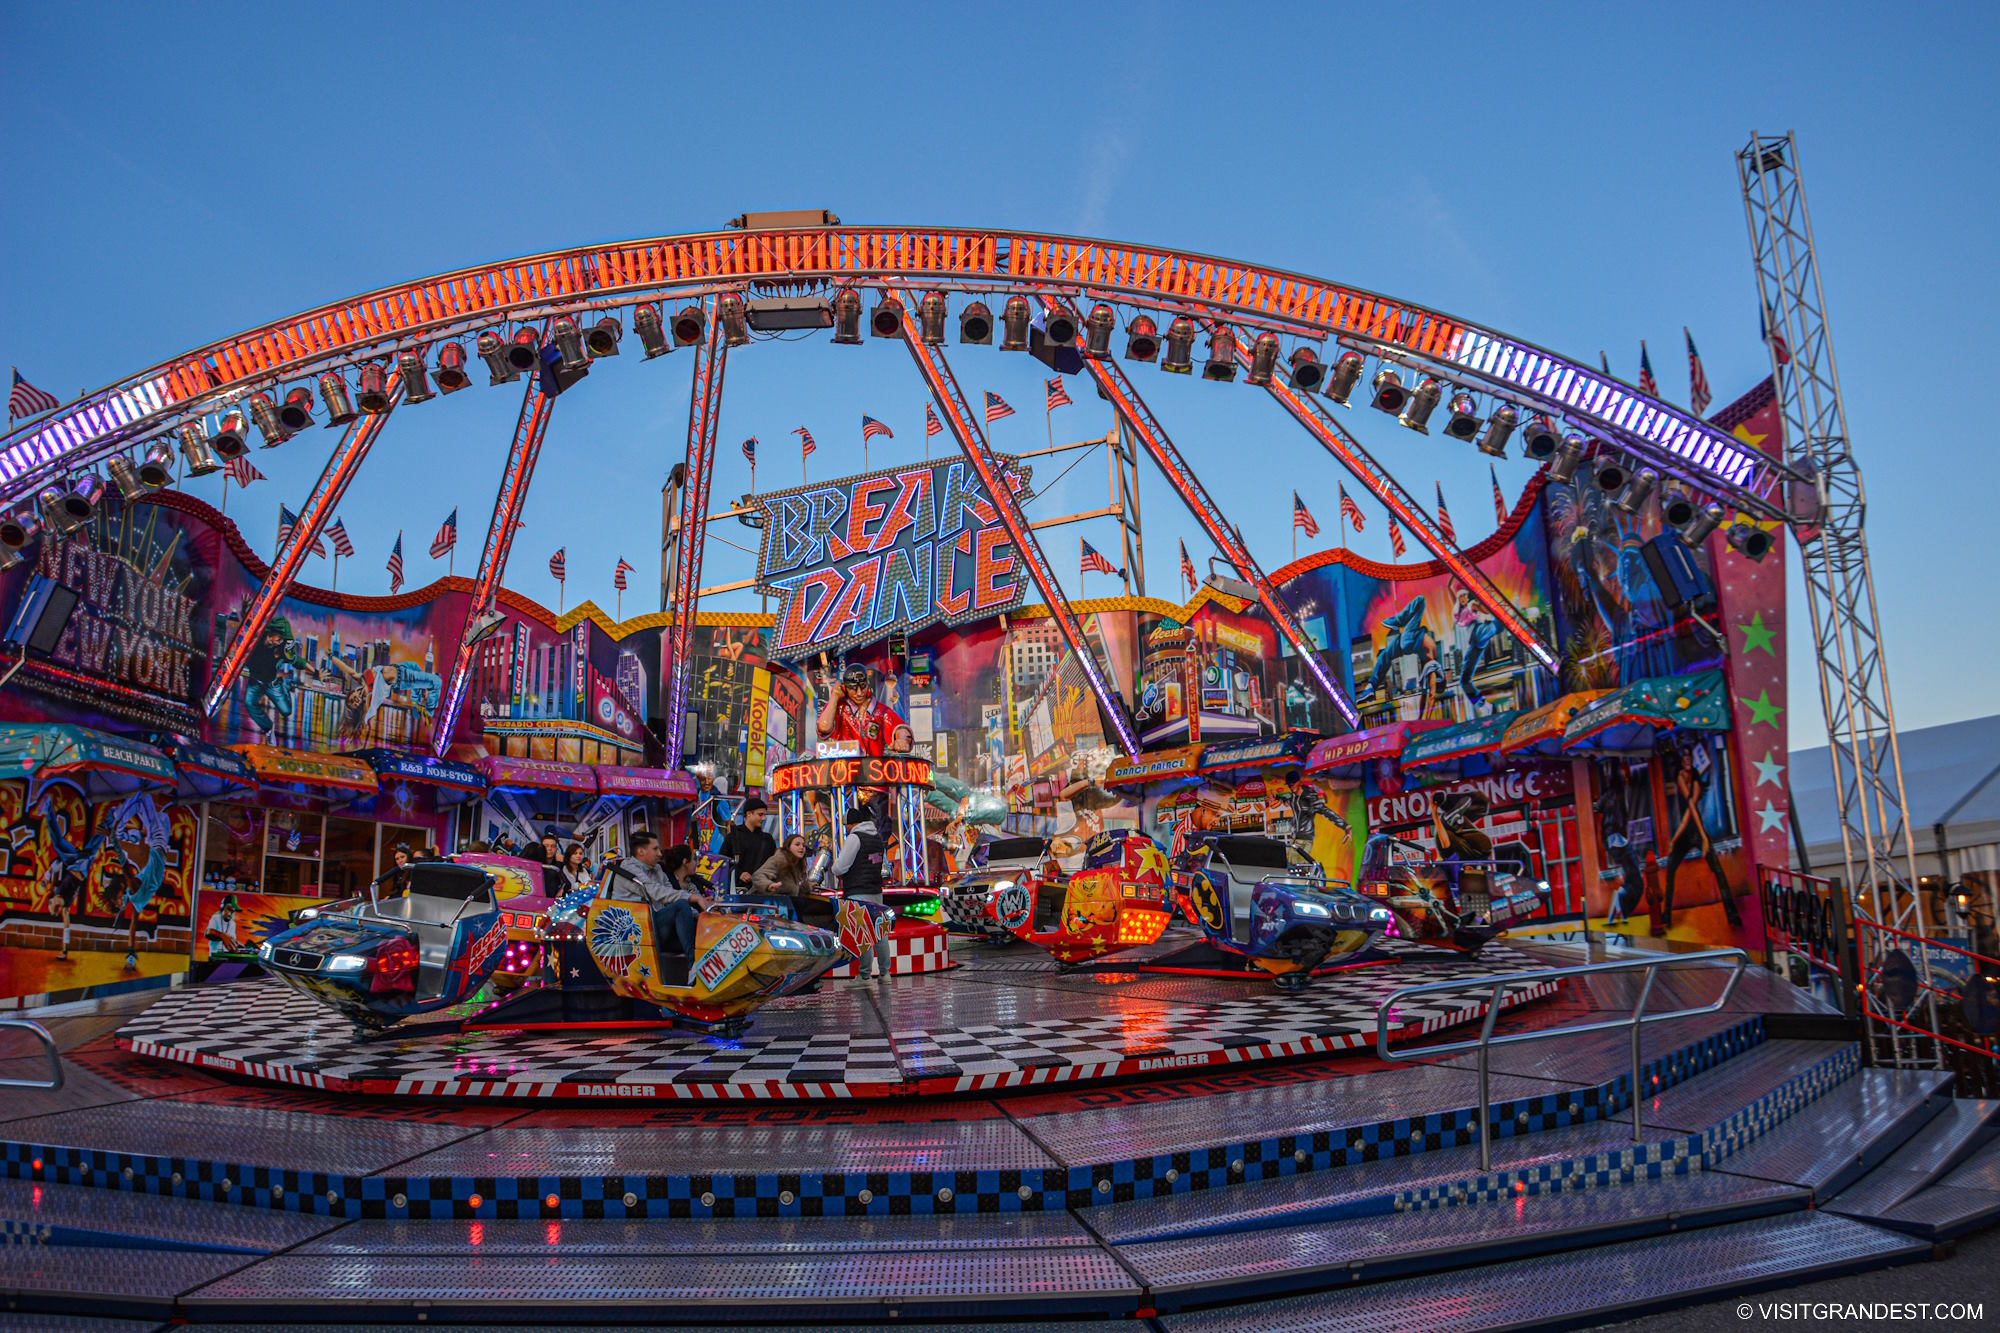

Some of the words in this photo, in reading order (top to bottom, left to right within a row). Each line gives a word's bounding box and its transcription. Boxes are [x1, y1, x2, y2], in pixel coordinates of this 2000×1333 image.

[763, 457, 1005, 576] BREAK
[770, 525, 1018, 649] DANCE
[122, 565, 198, 644] YORK
[118, 626, 191, 699] YORK
[513, 666, 522, 694] CITY
[576, 661, 584, 693] CITY
[772, 676, 800, 718] Kodak
[750, 697, 768, 756] Kodak
[102, 746, 133, 765] BEACH
[133, 753, 163, 771] PARTY
[1324, 748, 1344, 761] HIP
[1347, 741, 1369, 756] HOP
[277, 759, 322, 774] HOUSE
[401, 762, 424, 774] R&B
[427, 767, 474, 783] NON-STOP
[830, 759, 861, 784] OF
[869, 759, 931, 784] SOUND
[1115, 763, 1149, 777] DANCE
[1150, 759, 1185, 773] PALACE
[716, 932, 734, 948] YORK
[699, 951, 726, 984] KTW
[729, 926, 754, 954] 983
[202, 1054, 237, 1070] DANGER
[1138, 1053, 1210, 1071] DANGER
[577, 1085, 656, 1097] DANGER
